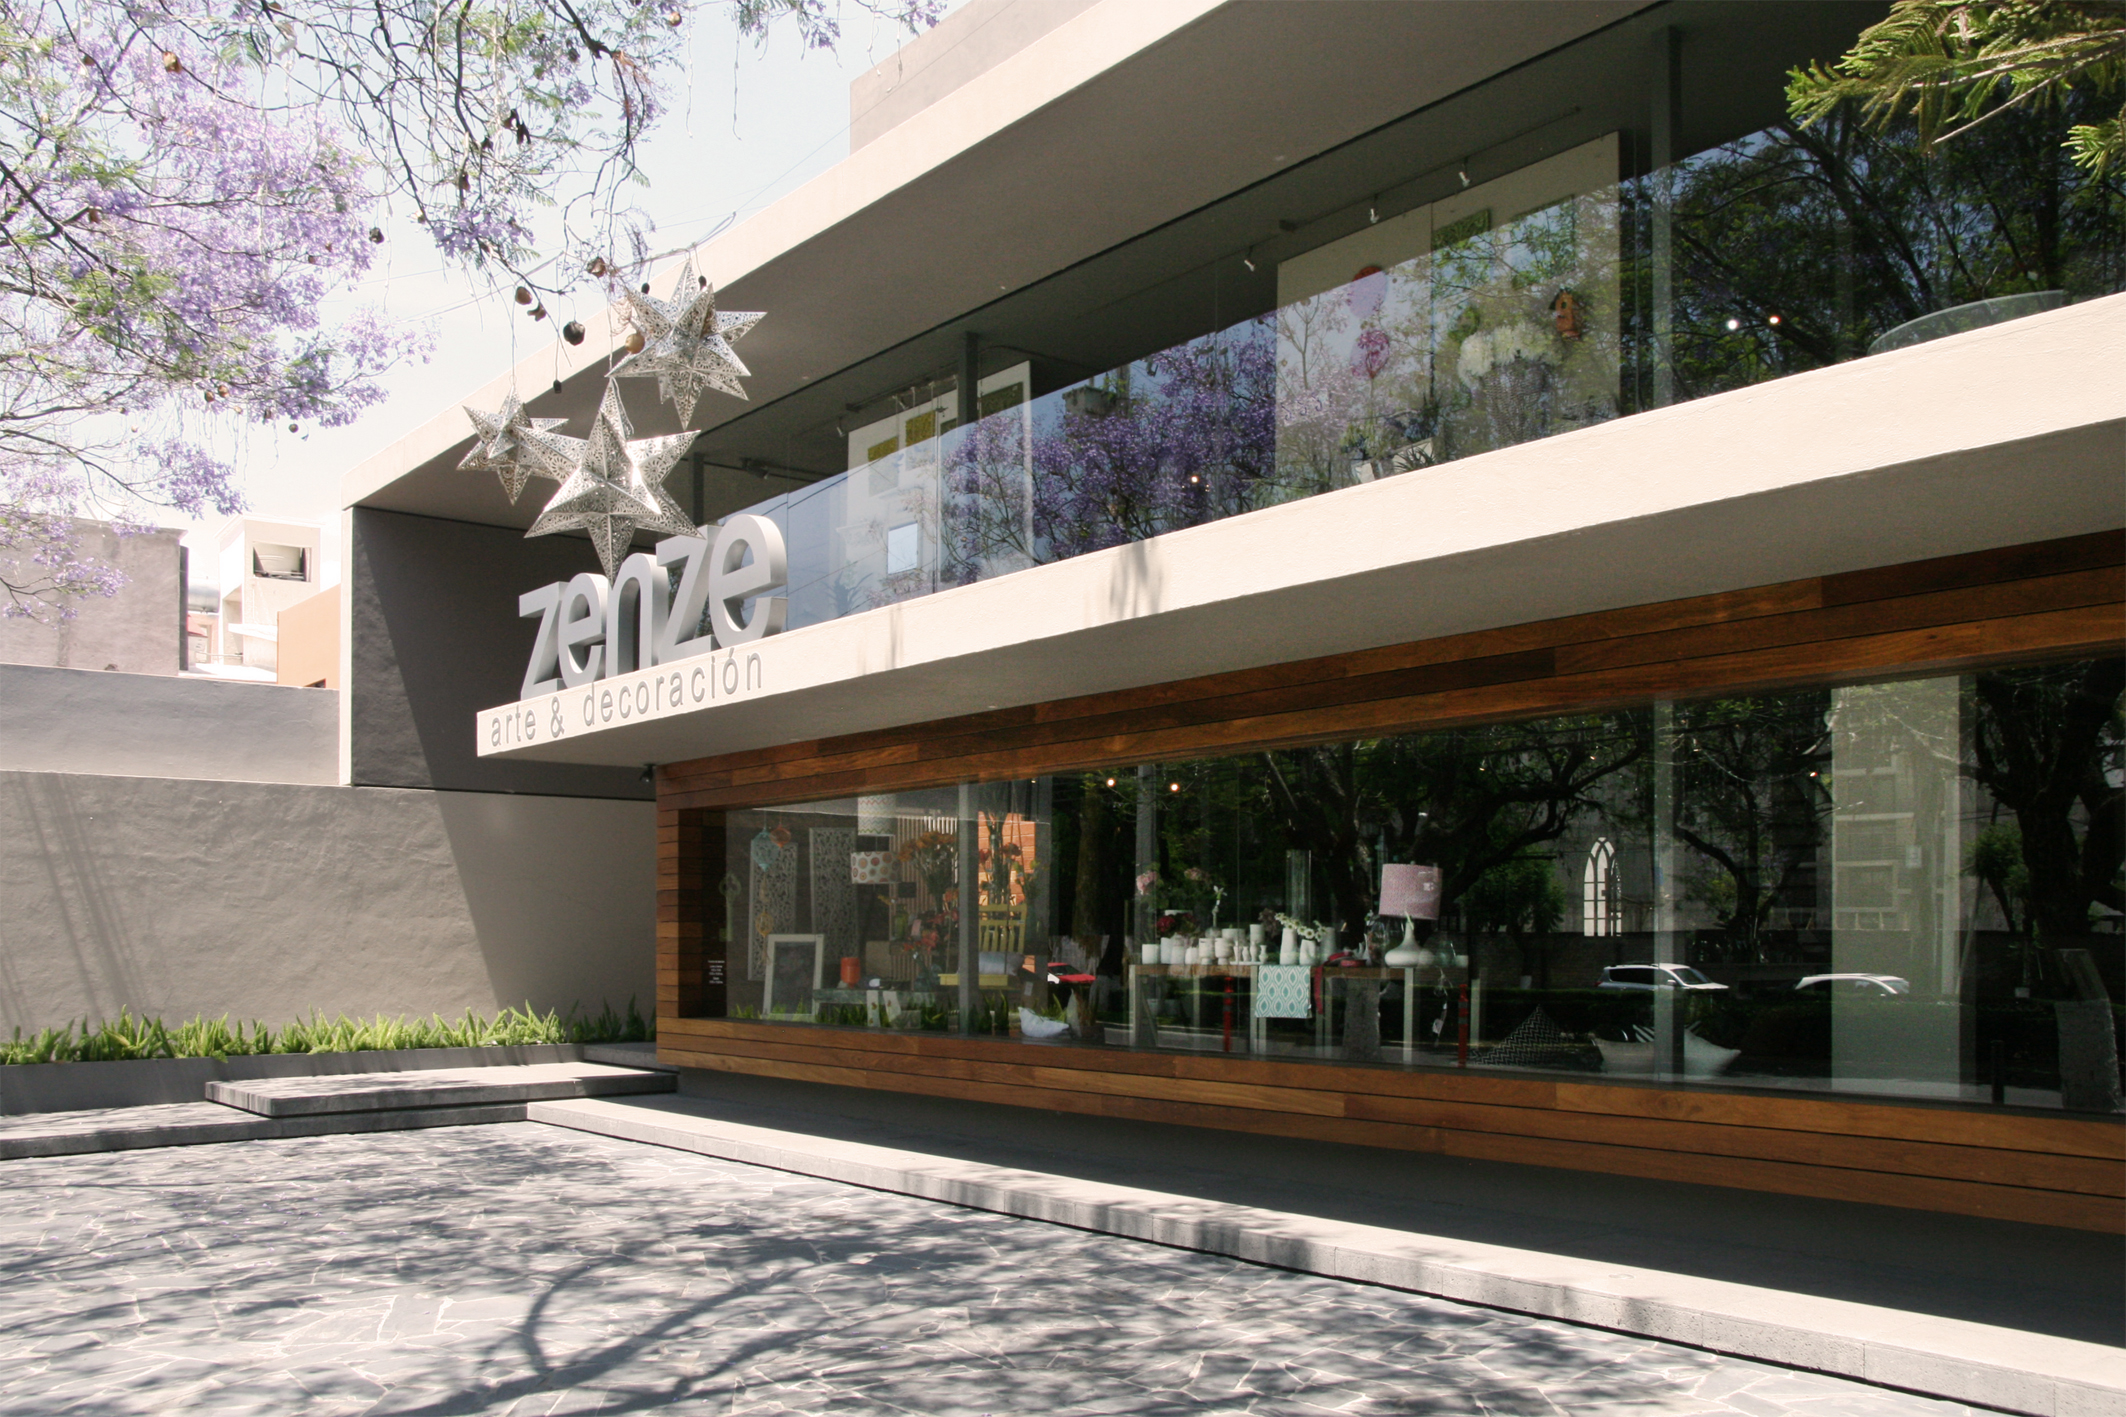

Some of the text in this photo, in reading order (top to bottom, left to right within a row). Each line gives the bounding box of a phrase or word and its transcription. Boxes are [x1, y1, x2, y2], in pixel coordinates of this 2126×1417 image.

[519, 514, 788, 701] zenze
[490, 648, 762, 747] arte & decoración
